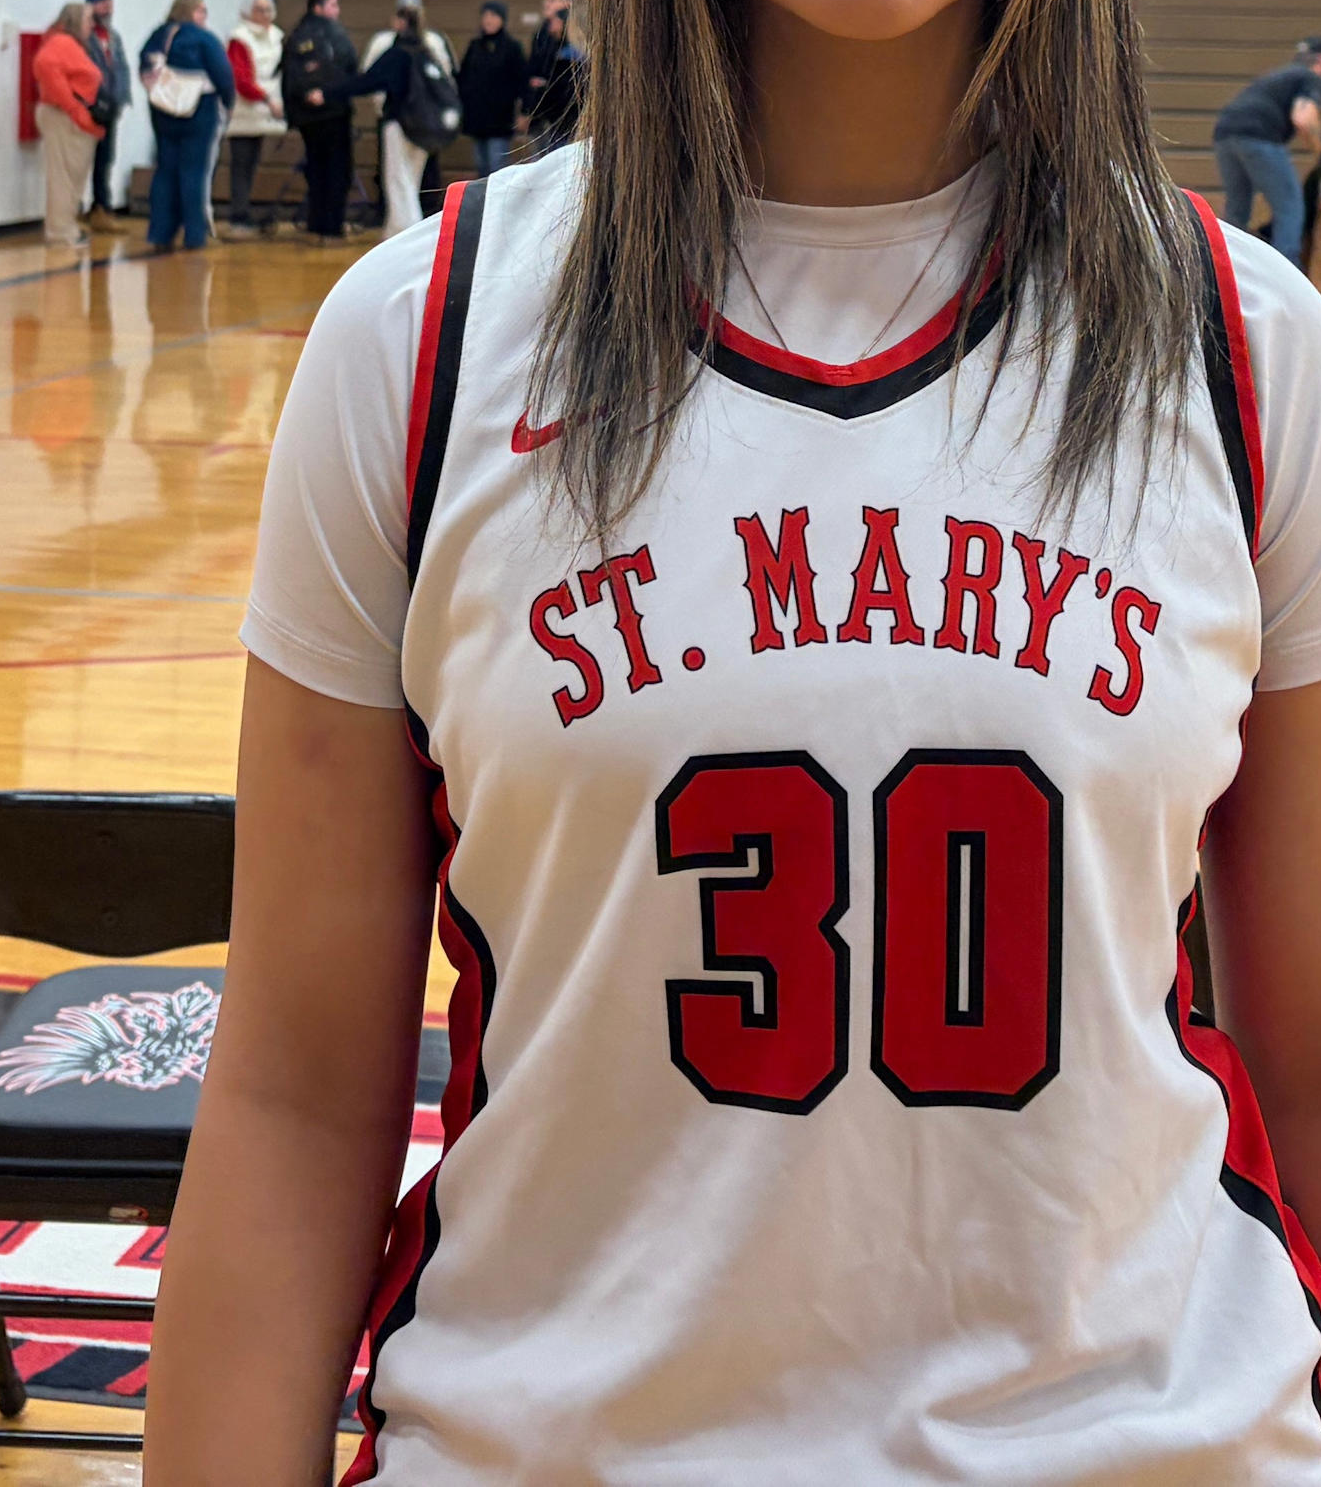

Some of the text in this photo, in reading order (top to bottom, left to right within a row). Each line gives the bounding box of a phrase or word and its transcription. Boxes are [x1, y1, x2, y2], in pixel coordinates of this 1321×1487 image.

[529, 505, 1163, 729] ST. MARY'S
[654, 747, 1066, 1117] 30
